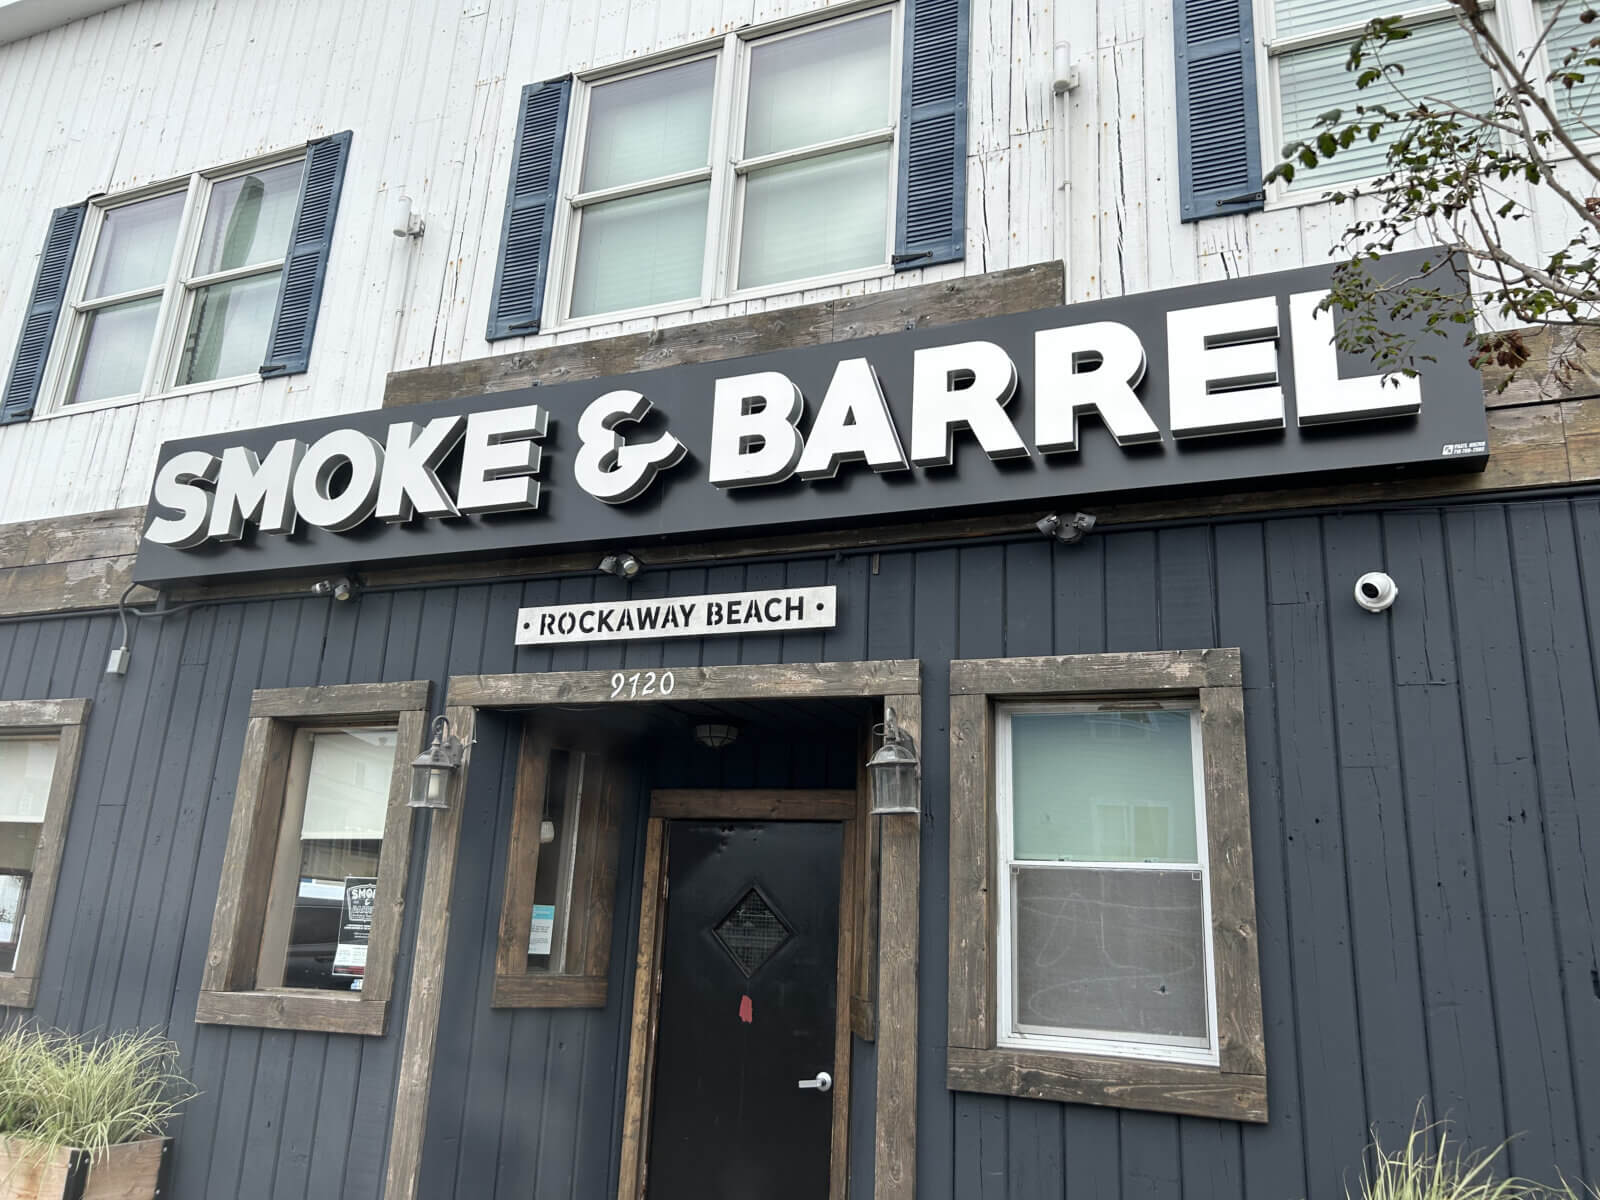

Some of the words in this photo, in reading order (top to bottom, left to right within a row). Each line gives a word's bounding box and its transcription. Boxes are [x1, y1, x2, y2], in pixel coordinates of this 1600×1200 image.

[145, 404, 549, 549] SMOKE
[574, 390, 688, 503] &
[709, 289, 1421, 488] BARREL
[539, 603, 696, 635] ROCKAWAY
[706, 596, 804, 625] BEACH
[610, 671, 675, 698] 9120
